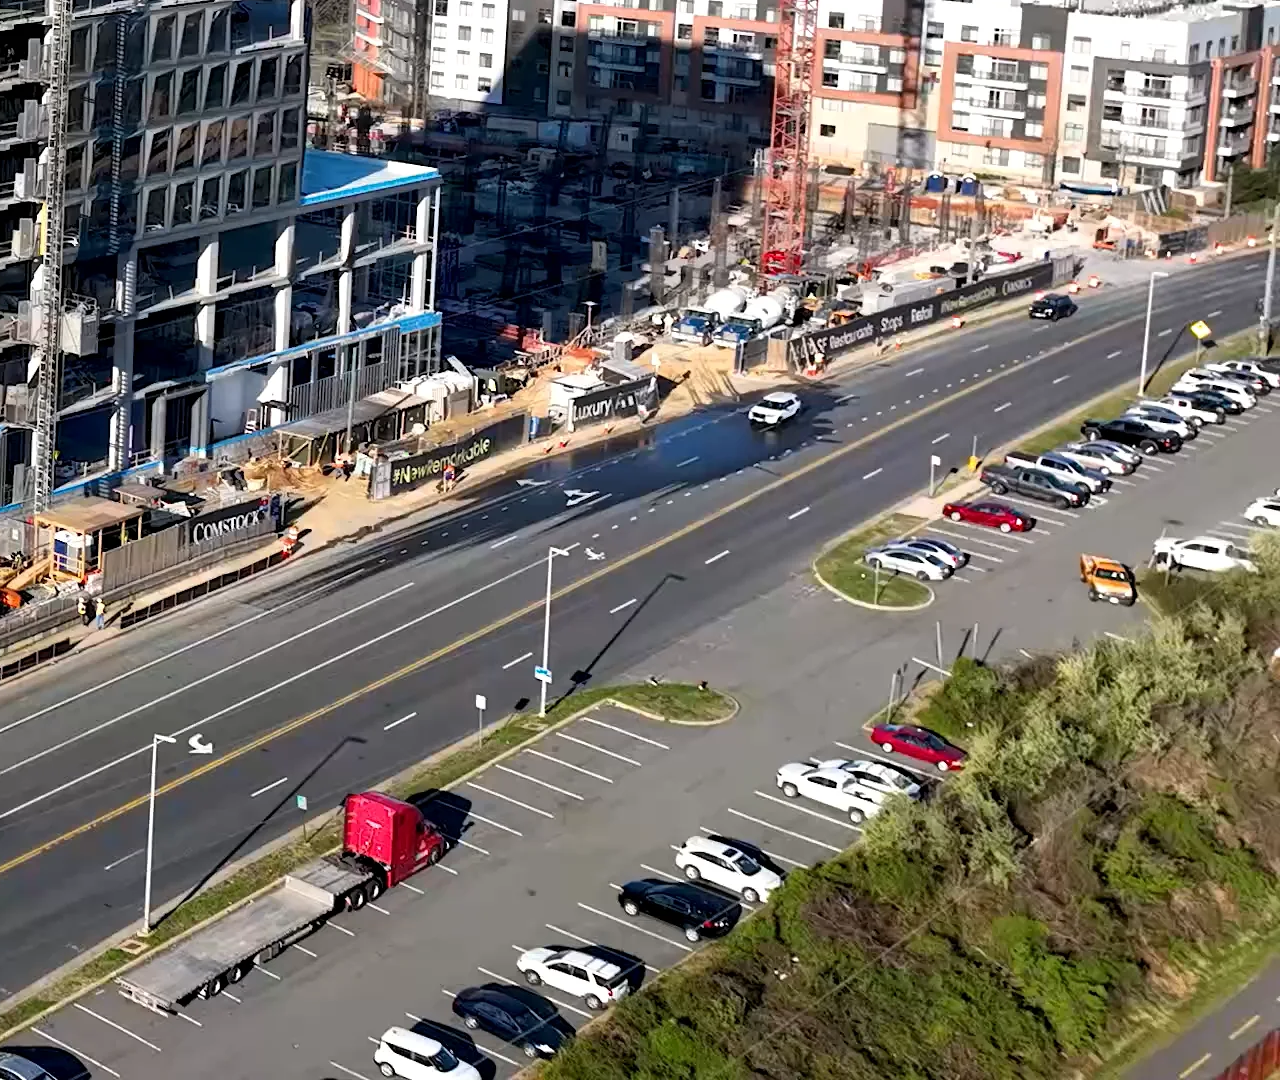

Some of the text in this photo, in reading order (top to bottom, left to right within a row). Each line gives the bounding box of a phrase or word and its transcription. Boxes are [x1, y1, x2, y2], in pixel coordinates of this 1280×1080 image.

[911, 304, 934, 322] Retail
[573, 399, 612, 421] Luxury
[393, 438, 491, 486] #NewRemarkable
[193, 510, 261, 545] COMSTOCK
